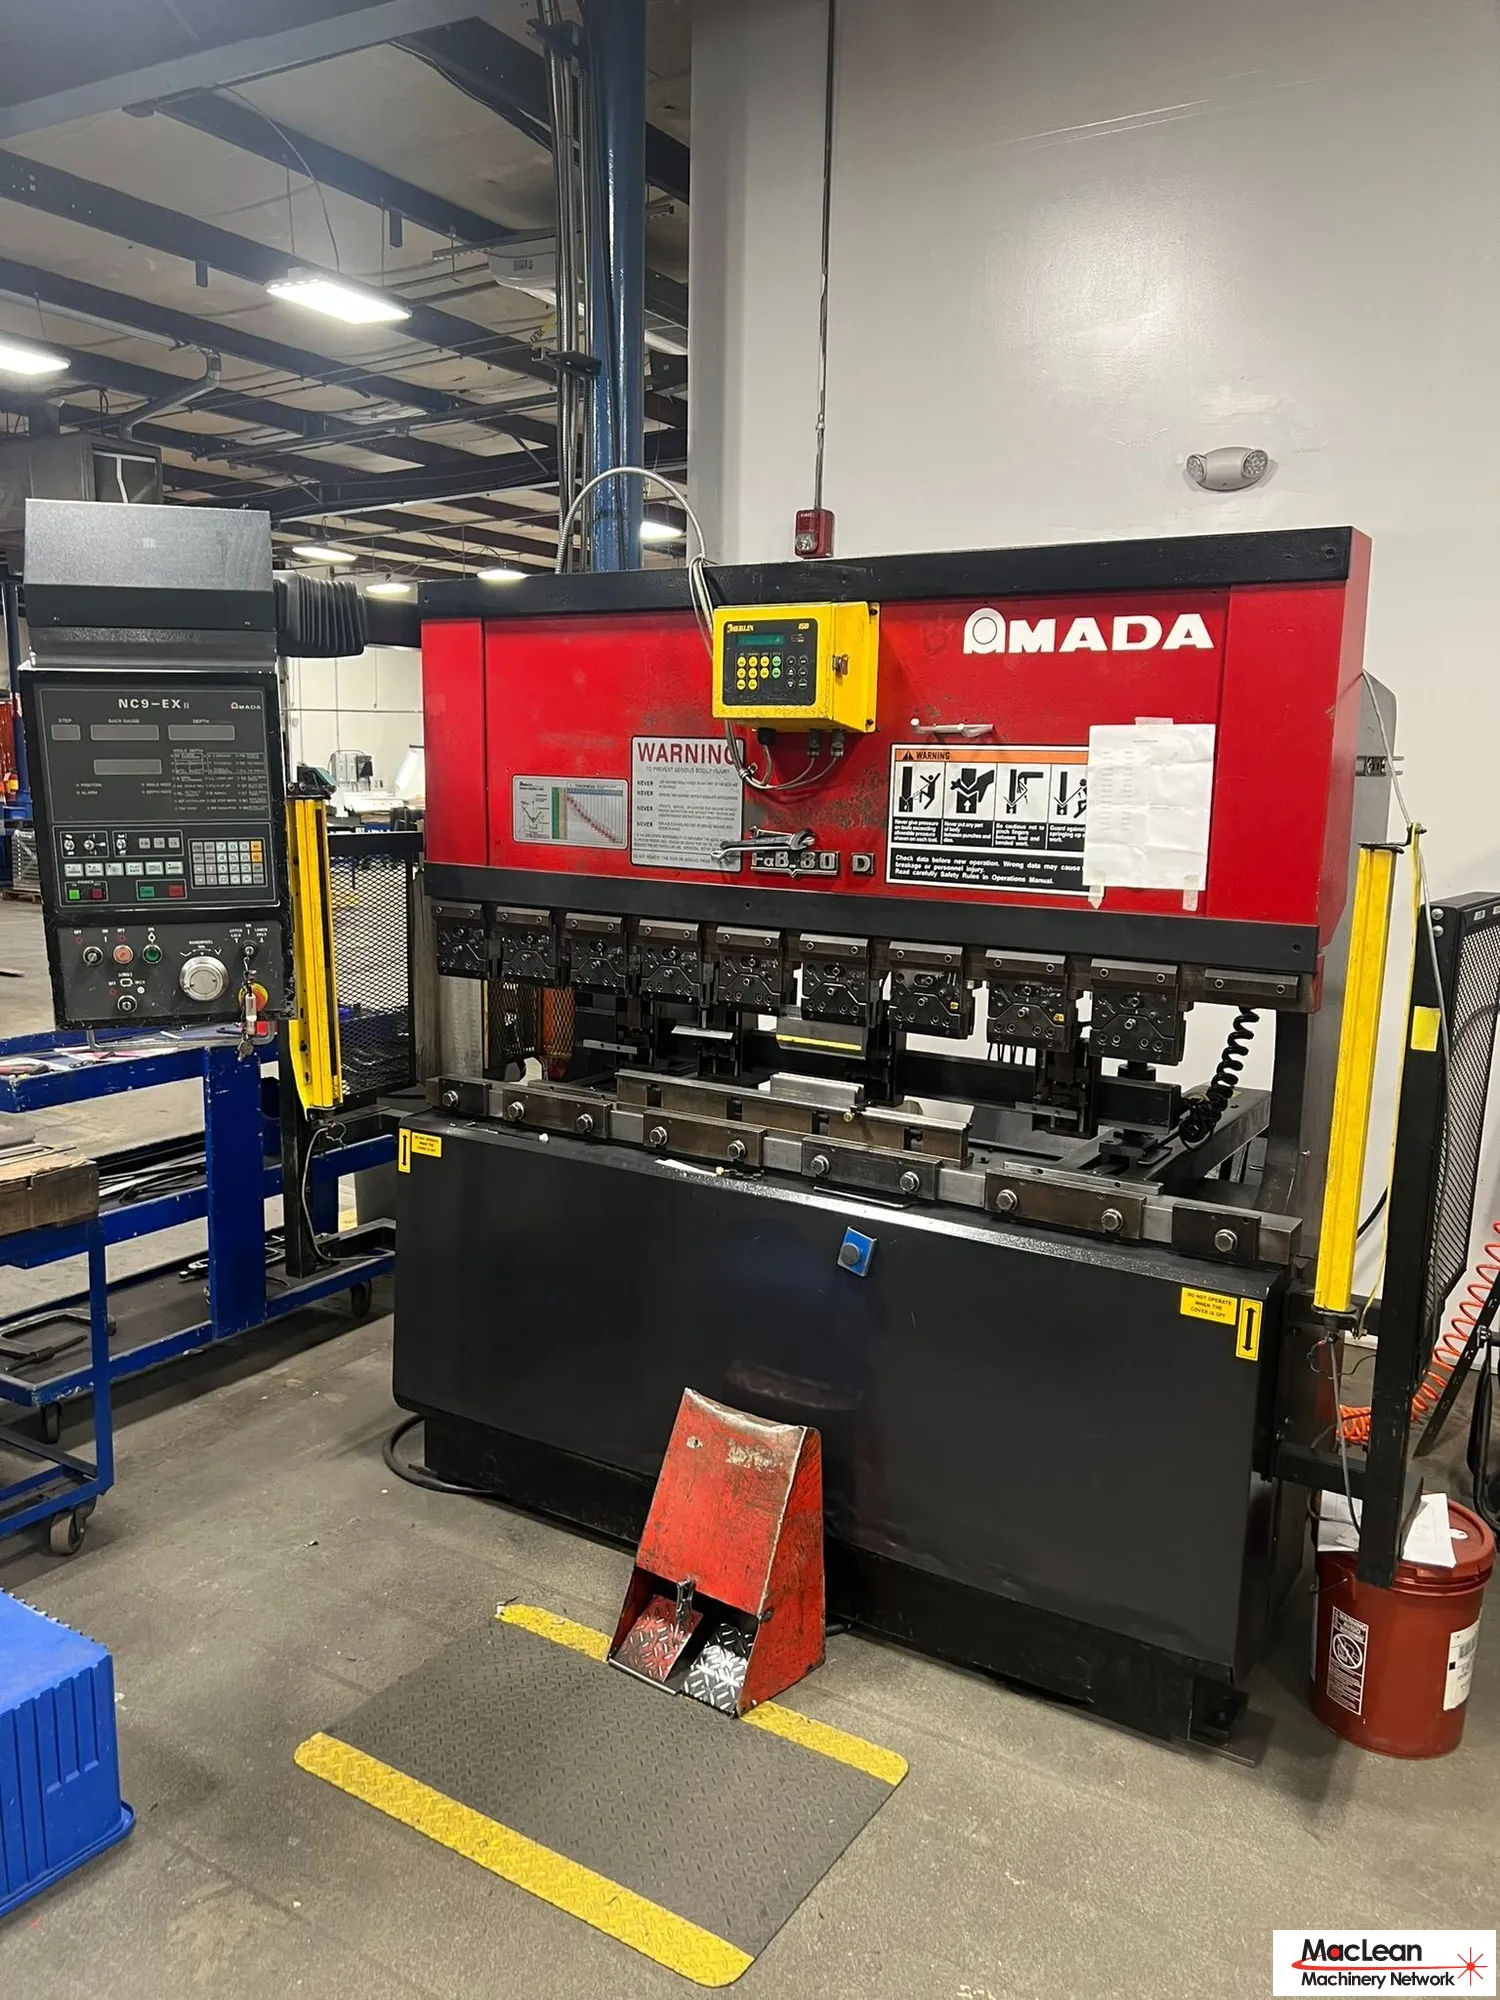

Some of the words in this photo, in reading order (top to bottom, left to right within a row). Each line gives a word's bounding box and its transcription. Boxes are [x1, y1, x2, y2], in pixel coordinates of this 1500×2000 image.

[963, 607, 1215, 655] AMADA
[230, 701, 262, 710] AMADA
[916, 750, 950, 761] WARNING
[895, 854, 914, 862] Check
[931, 856, 951, 864] before
[968, 859, 1000, 868] operation.
[1003, 860, 1024, 870] Wrong
[1043, 863, 1058, 872] may
[1060, 864, 1081, 872] cause
[895, 861, 922, 870] breakage
[933, 864, 964, 872] personnel
[966, 865, 985, 874] injury.
[912, 870, 938, 878] carefully
[940, 871, 960, 879] Safety
[991, 874, 1026, 882] Operations
[1028, 876, 1054, 884] Manual.
[1207, 1296, 1232, 1306] OPERATE
[1190, 1306, 1208, 1314] COVER
